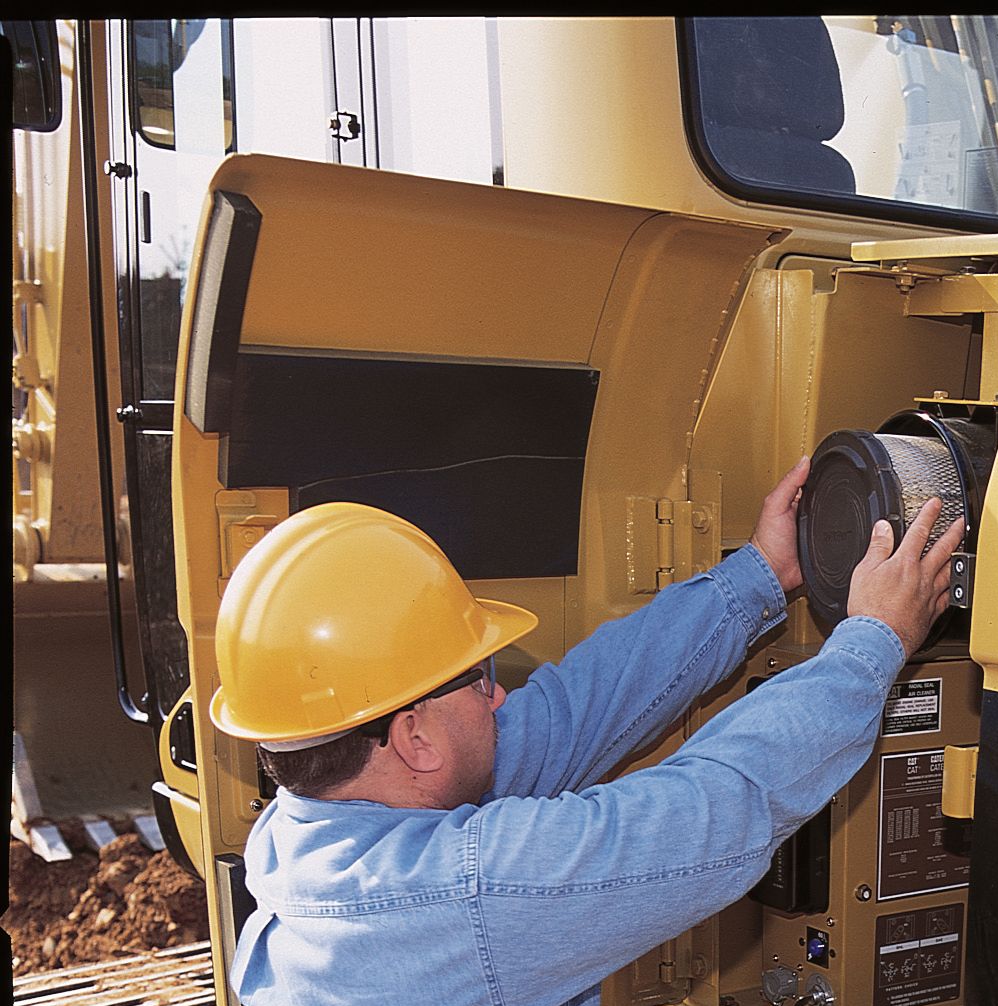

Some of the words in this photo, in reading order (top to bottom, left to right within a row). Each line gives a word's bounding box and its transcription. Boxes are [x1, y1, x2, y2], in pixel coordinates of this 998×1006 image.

[888, 685, 902, 699] AT
[930, 754, 945, 763] CATE
[907, 766, 919, 775] CAT
[929, 763, 945, 772] CATE
